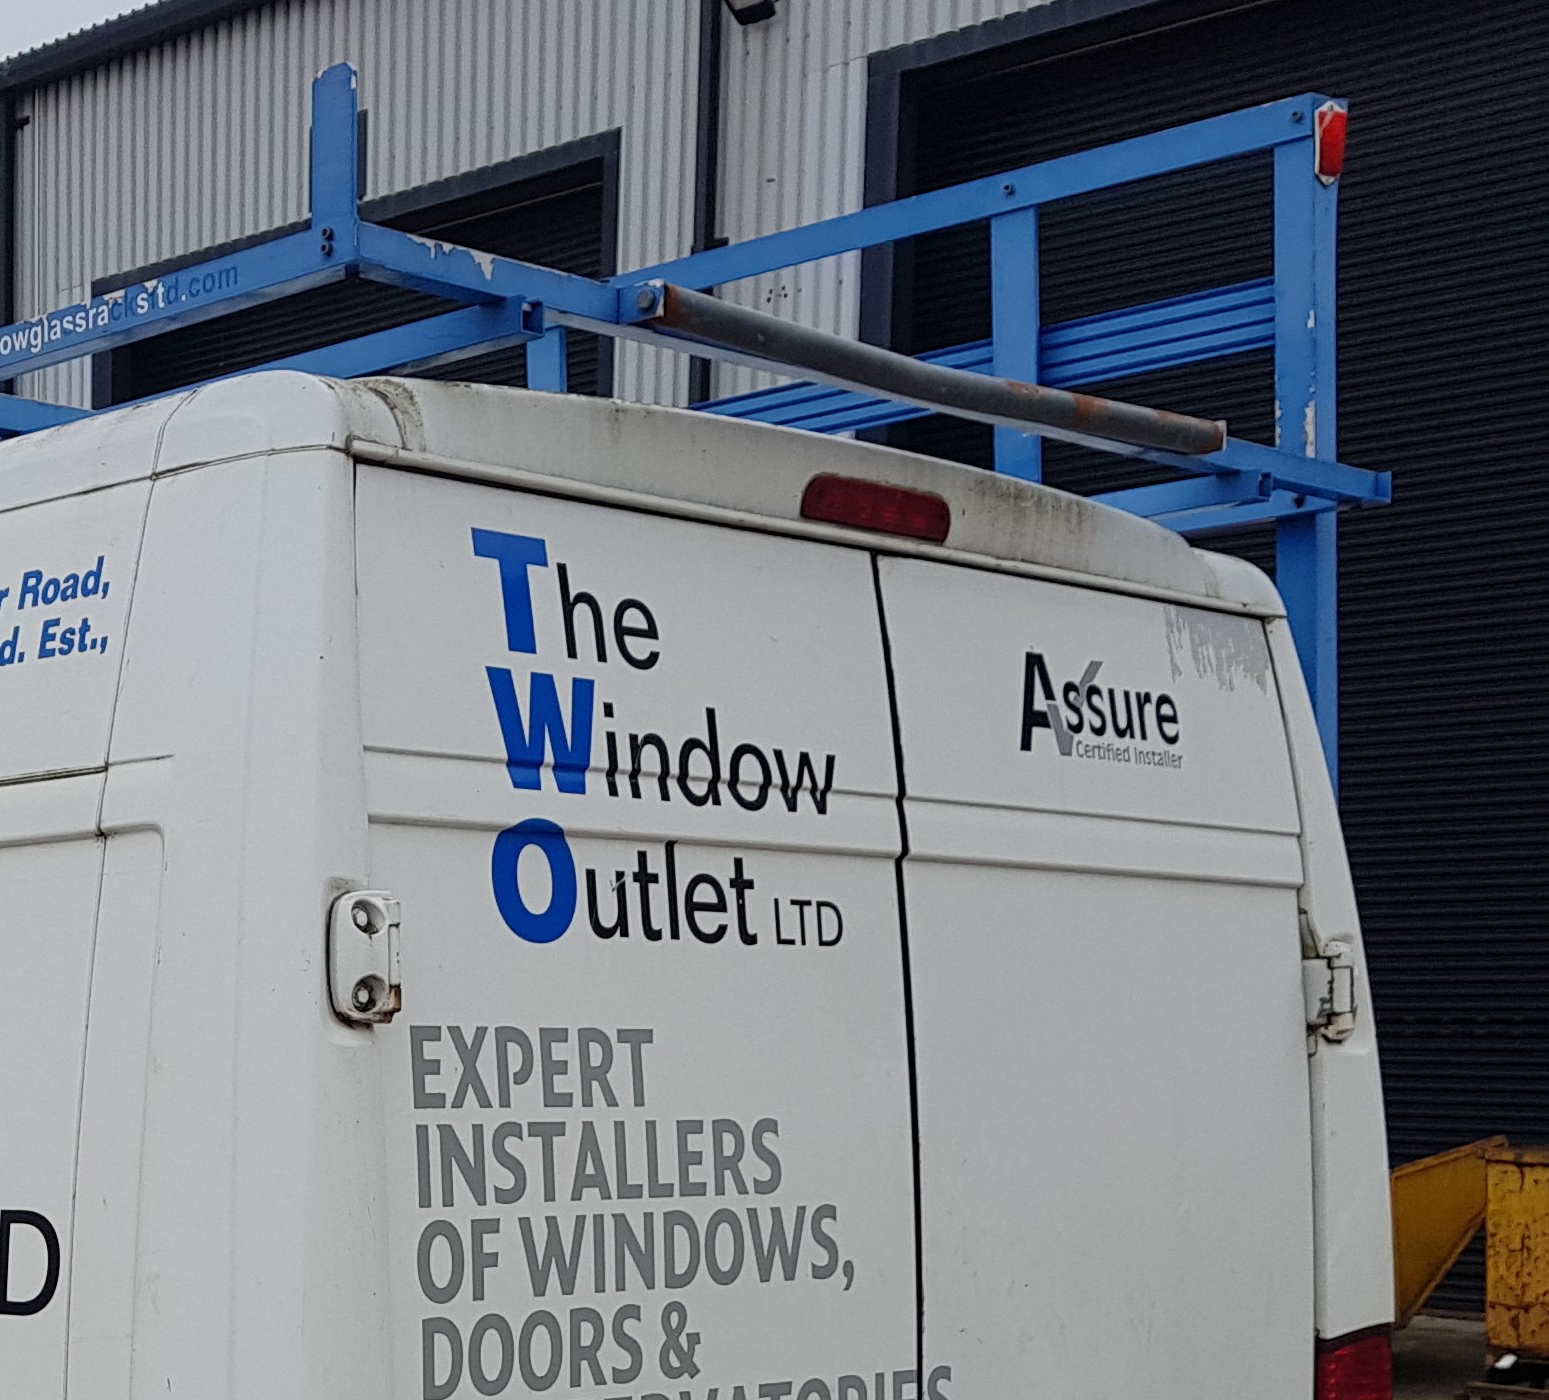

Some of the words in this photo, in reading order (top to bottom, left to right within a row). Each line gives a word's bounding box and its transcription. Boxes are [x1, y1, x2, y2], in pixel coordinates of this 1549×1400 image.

[17, 555, 110, 610] Road,
[471, 527, 661, 670] The
[37, 617, 109, 660] Est.,
[485, 665, 836, 816] Window
[1019, 651, 1180, 752] Assure
[1075, 740, 1131, 763] Certified
[1134, 746, 1184, 769] Installer
[491, 817, 758, 945] Outlet
[773, 897, 844, 948] LTD
[409, 1024, 654, 1109] EXPERT
[415, 1117, 782, 1208] INSTALLERS
[416, 1217, 501, 1304] OF
[518, 1204, 855, 1298] WINDOWS,
[658, 1300, 702, 1380] &
